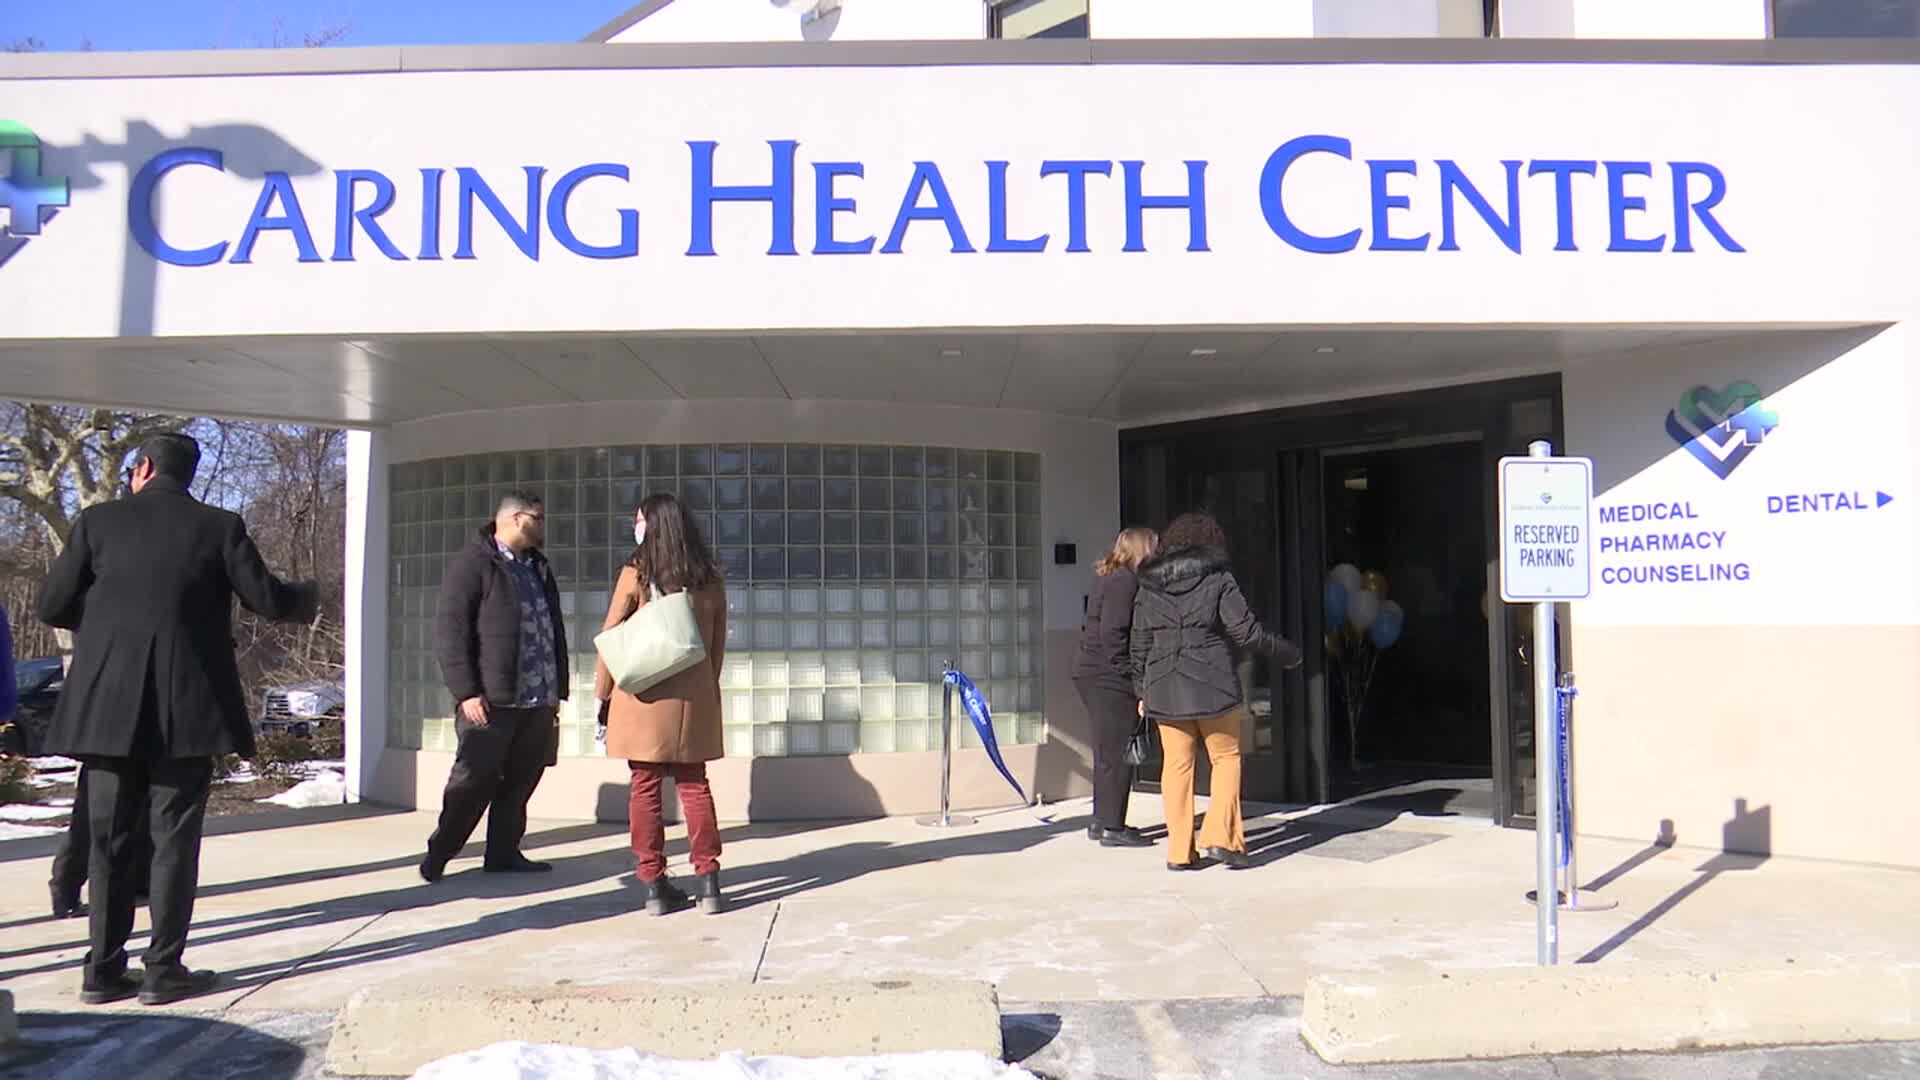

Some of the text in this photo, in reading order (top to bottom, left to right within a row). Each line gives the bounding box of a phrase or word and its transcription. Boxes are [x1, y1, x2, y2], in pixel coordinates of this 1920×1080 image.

[128, 134, 1748, 267] CARING HEALTH CENTER
[1599, 502, 1699, 523] MEDICAL
[1766, 491, 1868, 514] DENTAL
[1513, 524, 1580, 544] RESERVED
[1600, 531, 1727, 553] PHARMACY
[1519, 548, 1575, 568] PARKING
[1601, 563, 1751, 585] COUNSELING
